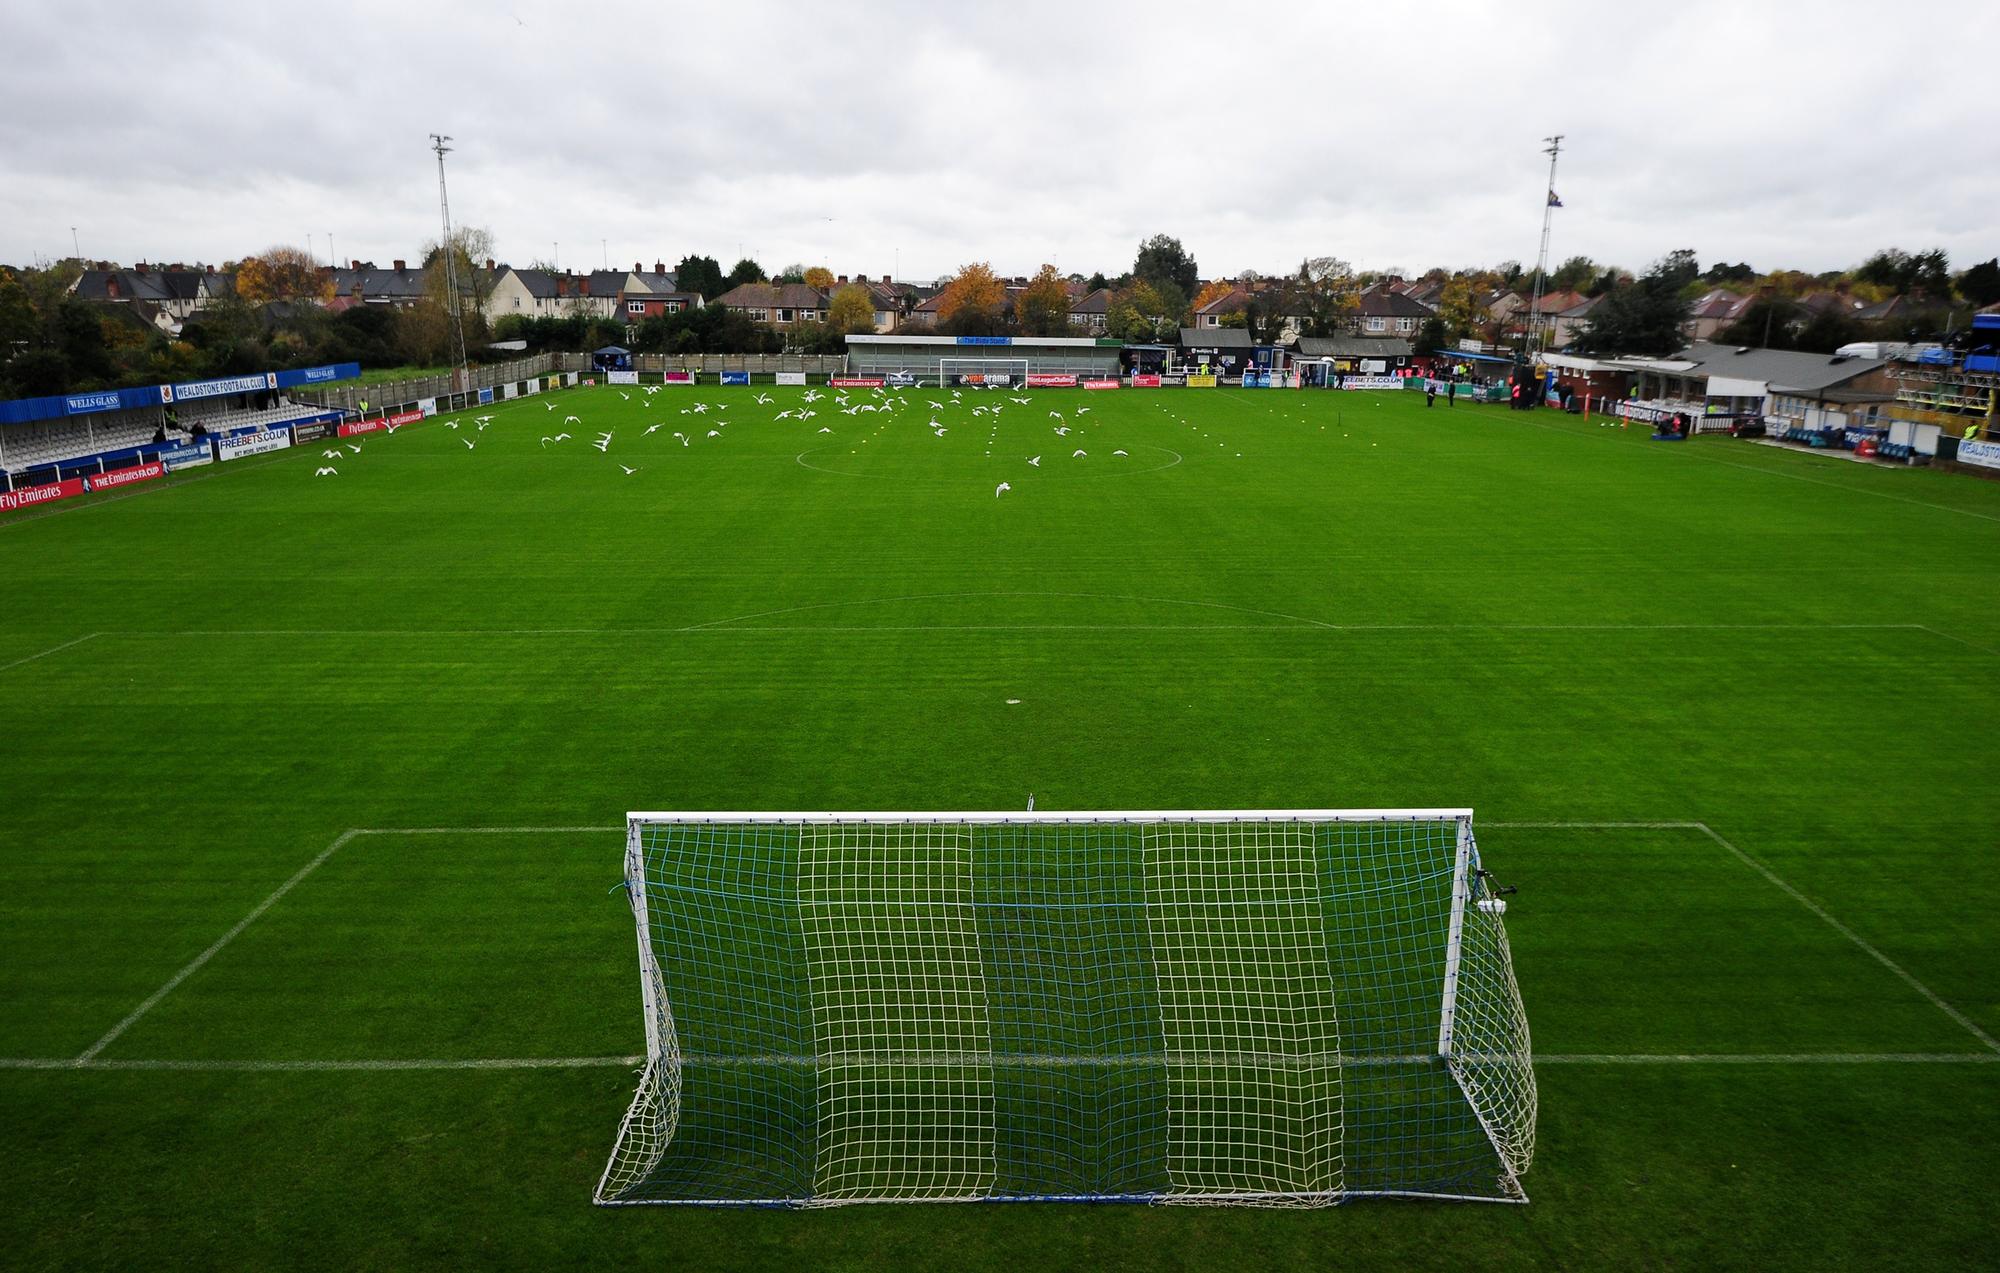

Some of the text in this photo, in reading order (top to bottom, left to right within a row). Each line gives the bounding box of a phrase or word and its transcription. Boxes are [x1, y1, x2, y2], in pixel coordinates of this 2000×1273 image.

[177, 377, 266, 398] WEALDSTONE FOOTBALL CLUB
[69, 397, 95, 409] WELLS
[95, 395, 118, 406] GLASS
[349, 421, 376, 434] Fly Emirates
[220, 428, 288, 450] FREEBETS.CO.UK
[95, 466, 160, 488] THE Emirates FA CUP
[0, 486, 61, 508] Fly Emirates
